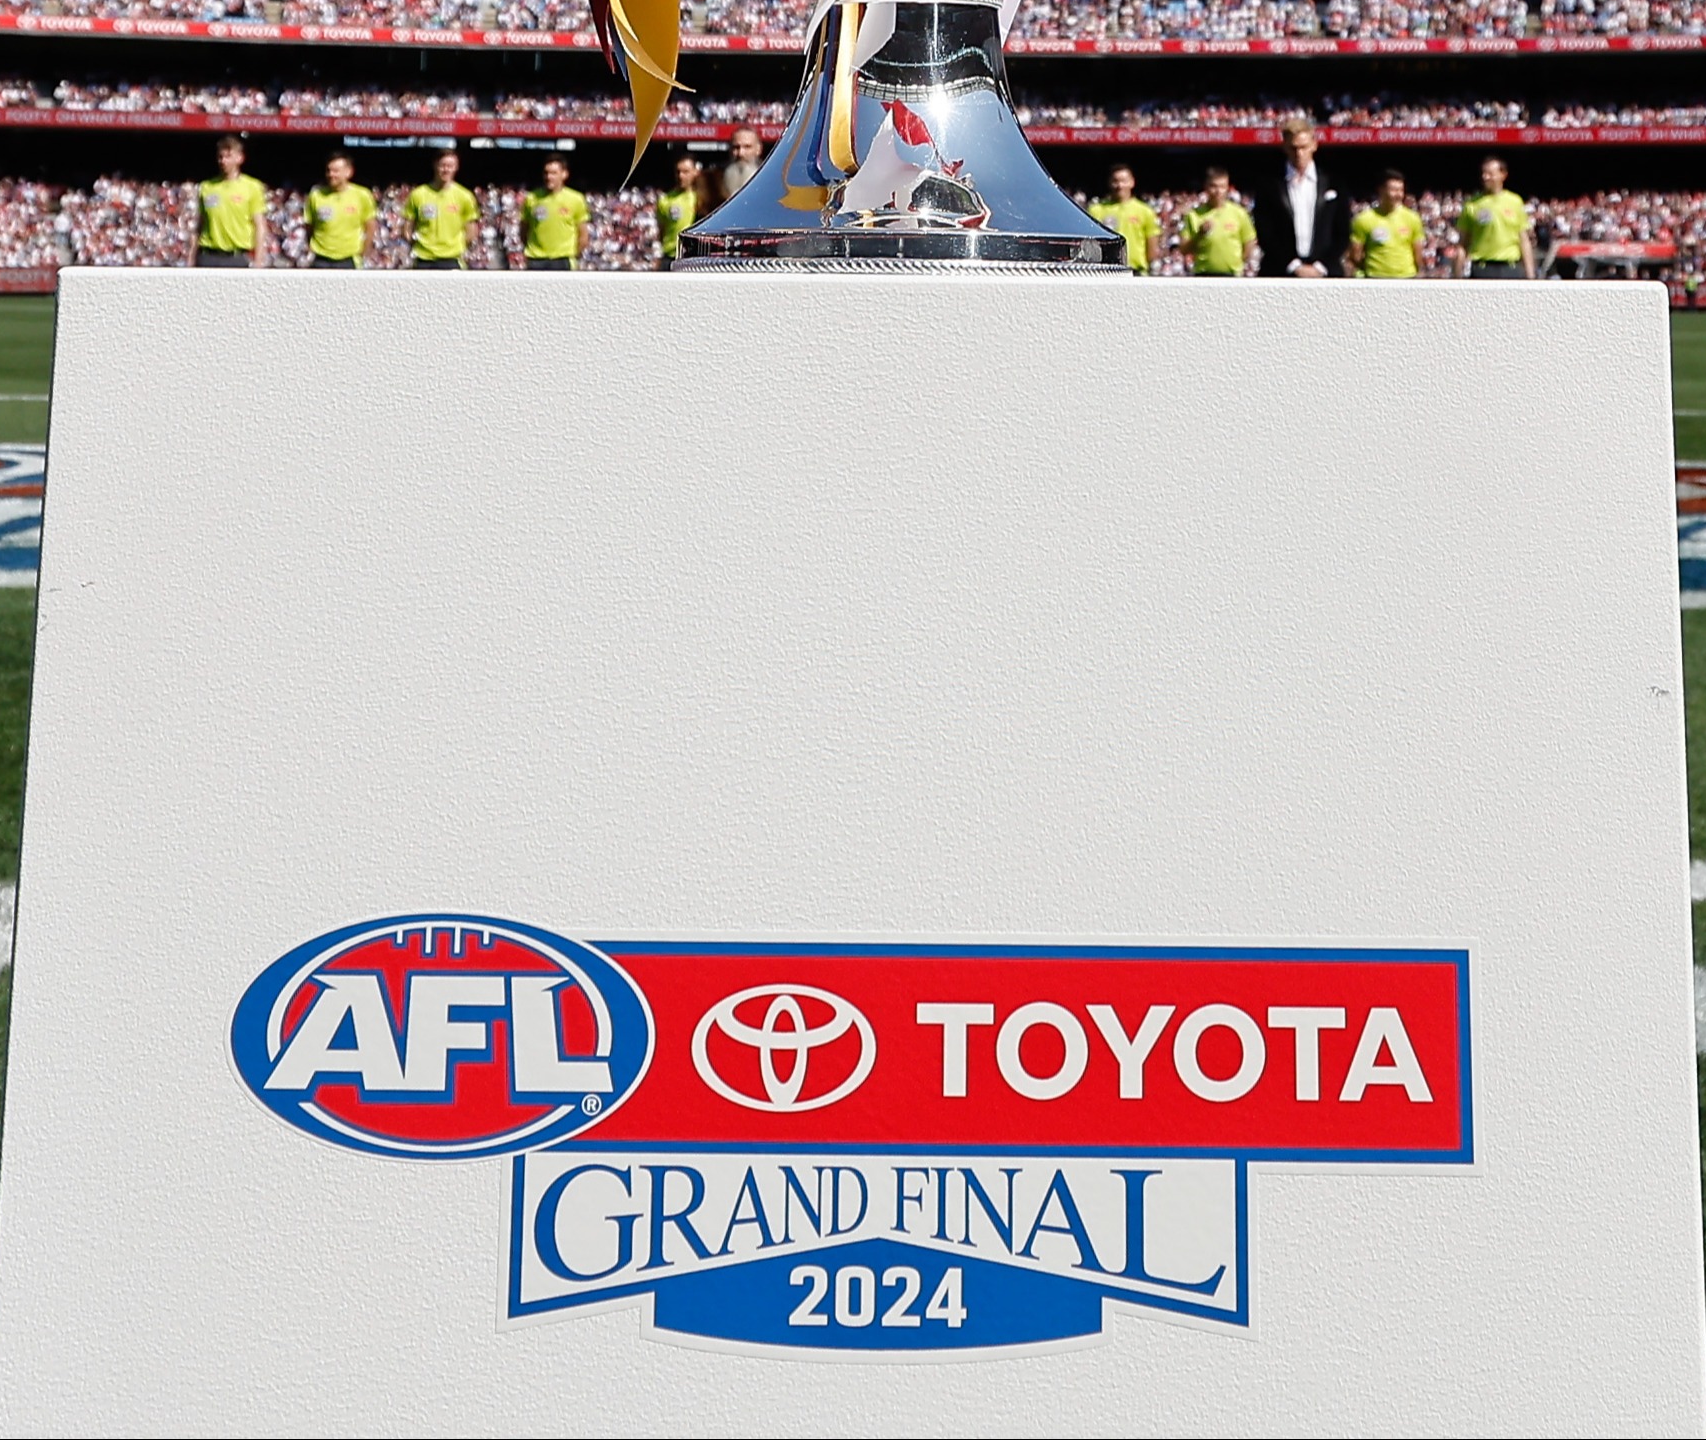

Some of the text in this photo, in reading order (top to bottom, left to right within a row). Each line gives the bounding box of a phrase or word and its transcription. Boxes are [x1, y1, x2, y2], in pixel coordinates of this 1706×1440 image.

[40, 16, 92, 30] TOYOTA
[135, 20, 187, 34] TOYOTA
[229, 23, 279, 37] TOYOTA
[323, 27, 372, 40] TOYOTA
[413, 30, 461, 43] TOYOTA
[505, 32, 552, 45] TOYOTA
[680, 35, 728, 48] TOYOTA
[768, 37, 805, 50] TOYOT
[1469, 39, 1517, 51] TOYOTA
[1559, 38, 1609, 50] TOYOTA
[1650, 36, 1701, 48] TOYOTA
[1028, 42, 1074, 52] TOYOTA
[1116, 41, 1161, 52] TOYOTA
[1291, 41, 1337, 52] TOYOTA
[1379, 40, 1427, 52] TOYOTA
[55, 112, 76, 124] OH
[77, 112, 116, 124] WHAT
[230, 116, 280, 129] TOYOTA
[334, 118, 354, 130] OH
[355, 119, 392, 131] WHAT
[400, 120, 453, 132] FEELING!
[499, 122, 548, 134] TOYOTA
[599, 123, 619, 135] OH
[664, 124, 716, 136] FEELING!
[1138, 129, 1174, 140] WHAT
[1183, 129, 1233, 141] FEELING!
[1542, 129, 1593, 140] TOYOTA
[263, 973, 1434, 1103] AFL TOYOTA
[533, 1163, 1226, 1298] GRAND FINAL
[787, 1265, 968, 1329] 2024
